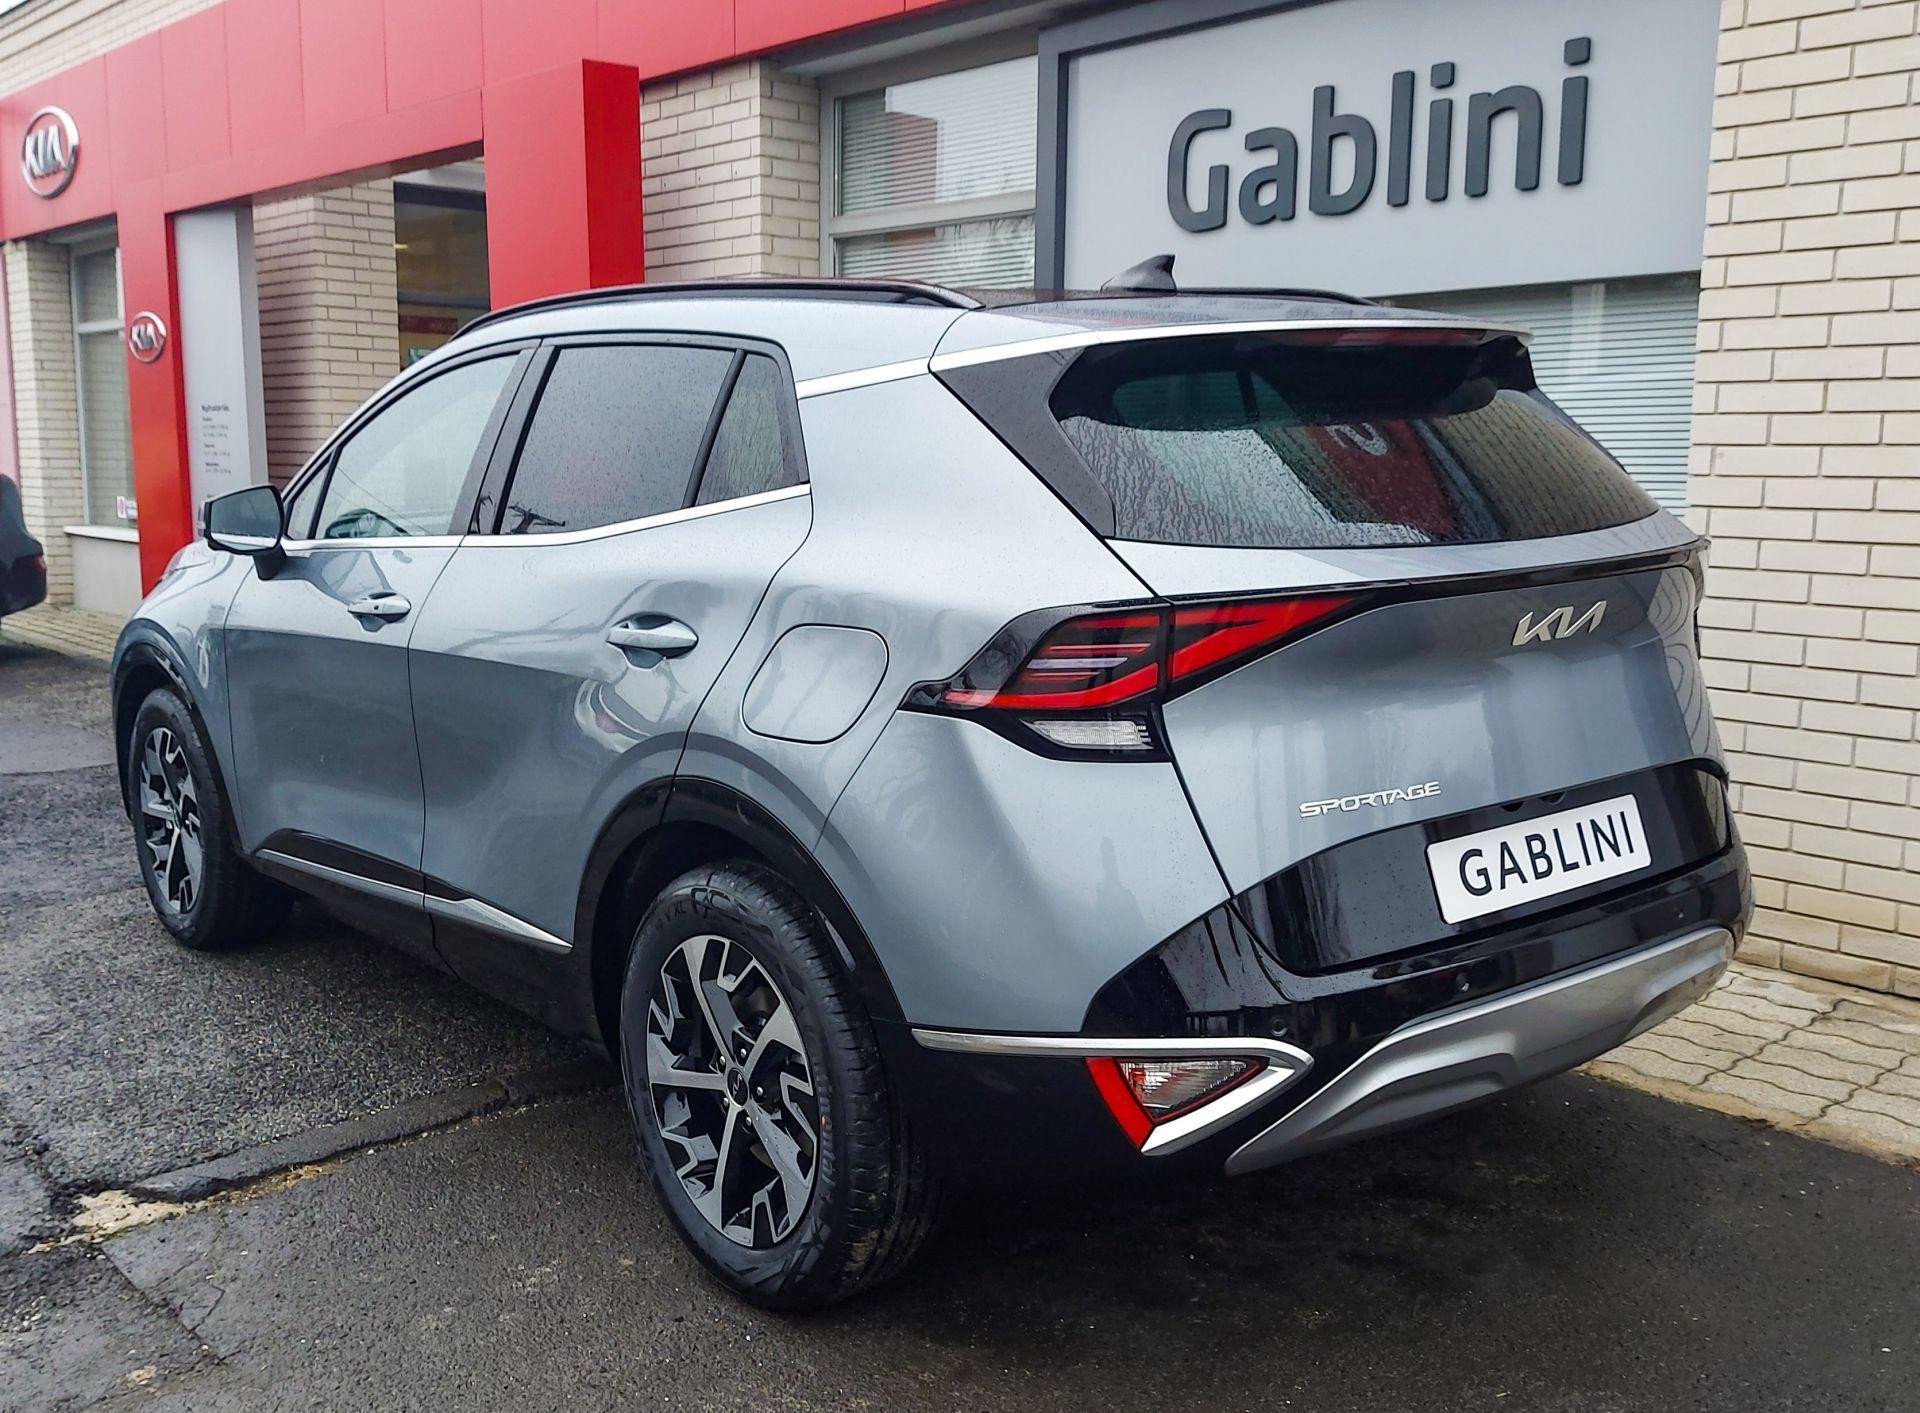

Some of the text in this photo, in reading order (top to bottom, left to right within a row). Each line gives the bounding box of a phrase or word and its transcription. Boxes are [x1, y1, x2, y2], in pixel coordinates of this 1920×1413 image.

[25, 125, 67, 178] KIA
[1167, 37, 1591, 233] Gablini
[131, 322, 159, 351] KIA
[1512, 600, 1607, 646] KIA
[1299, 781, 1441, 818] SPORTAGE
[1459, 811, 1635, 897] GABLINI
